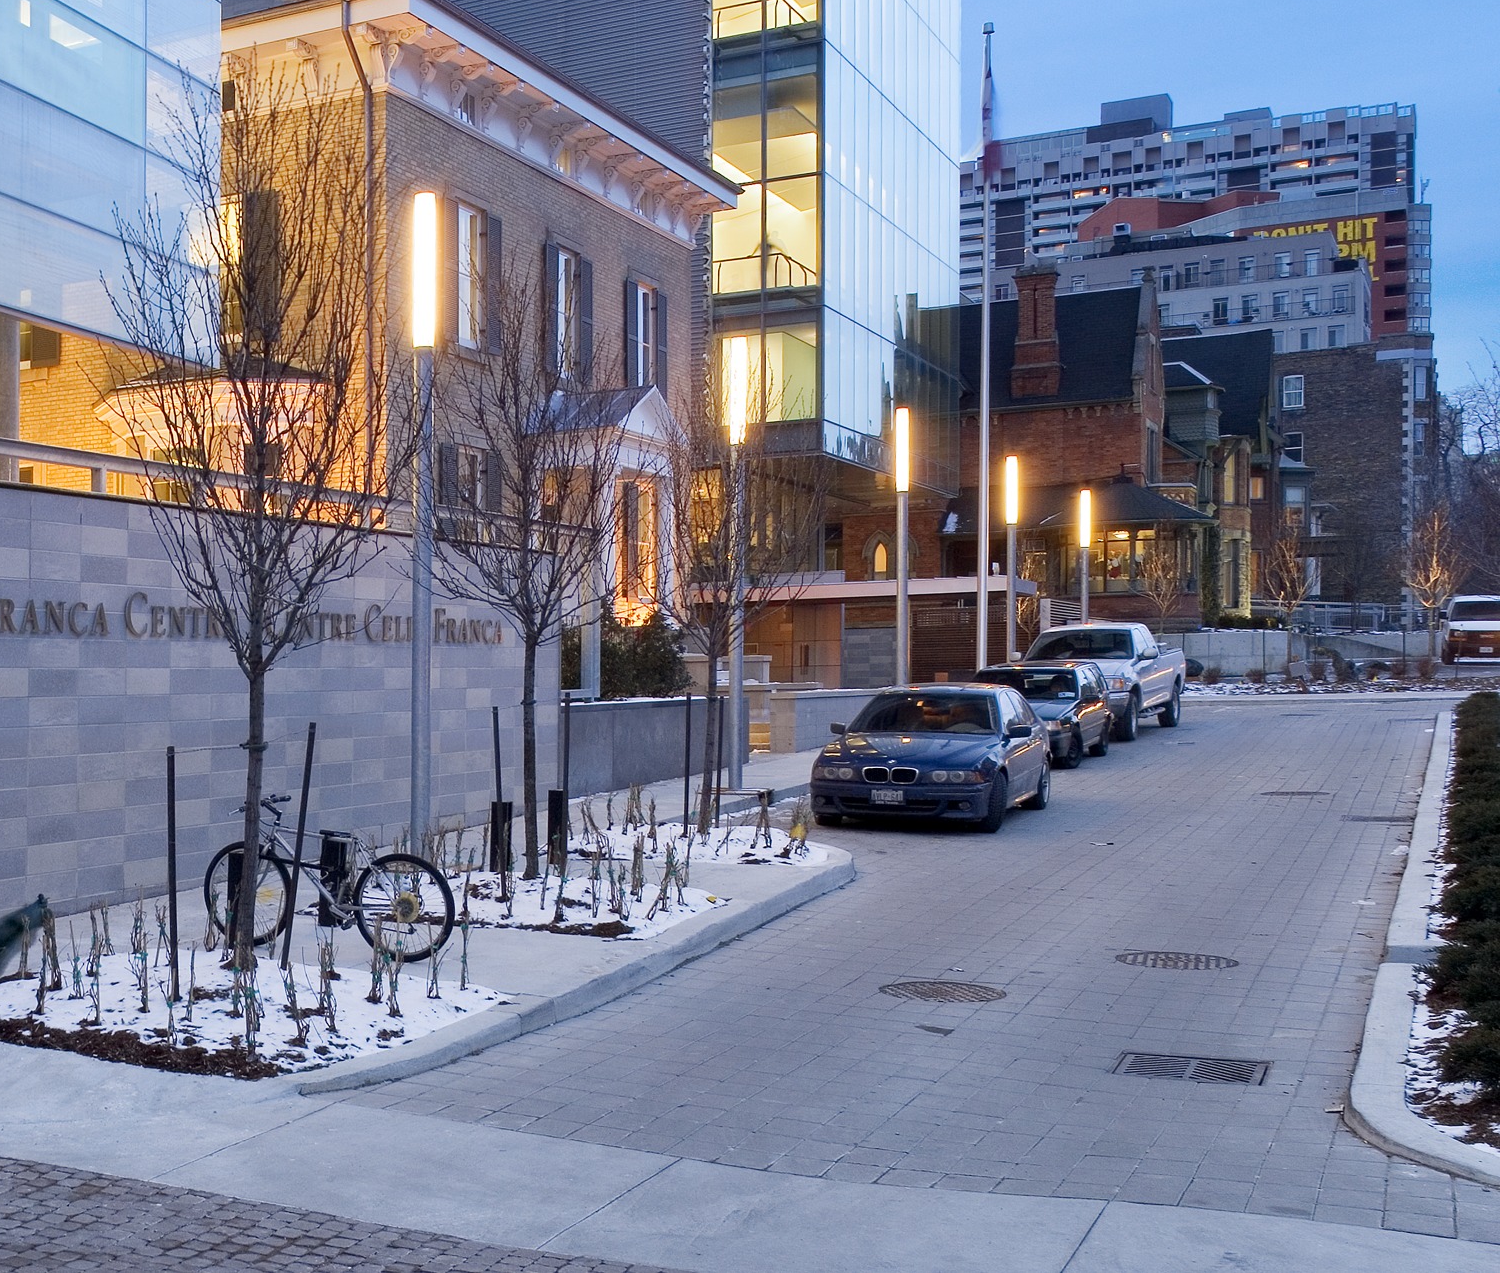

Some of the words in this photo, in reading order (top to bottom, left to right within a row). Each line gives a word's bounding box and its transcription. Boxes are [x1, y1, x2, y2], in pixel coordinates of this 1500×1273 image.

[1337, 217, 1378, 241] HIT
[364, 603, 412, 642] CELI
[434, 607, 503, 644] FRANCA
